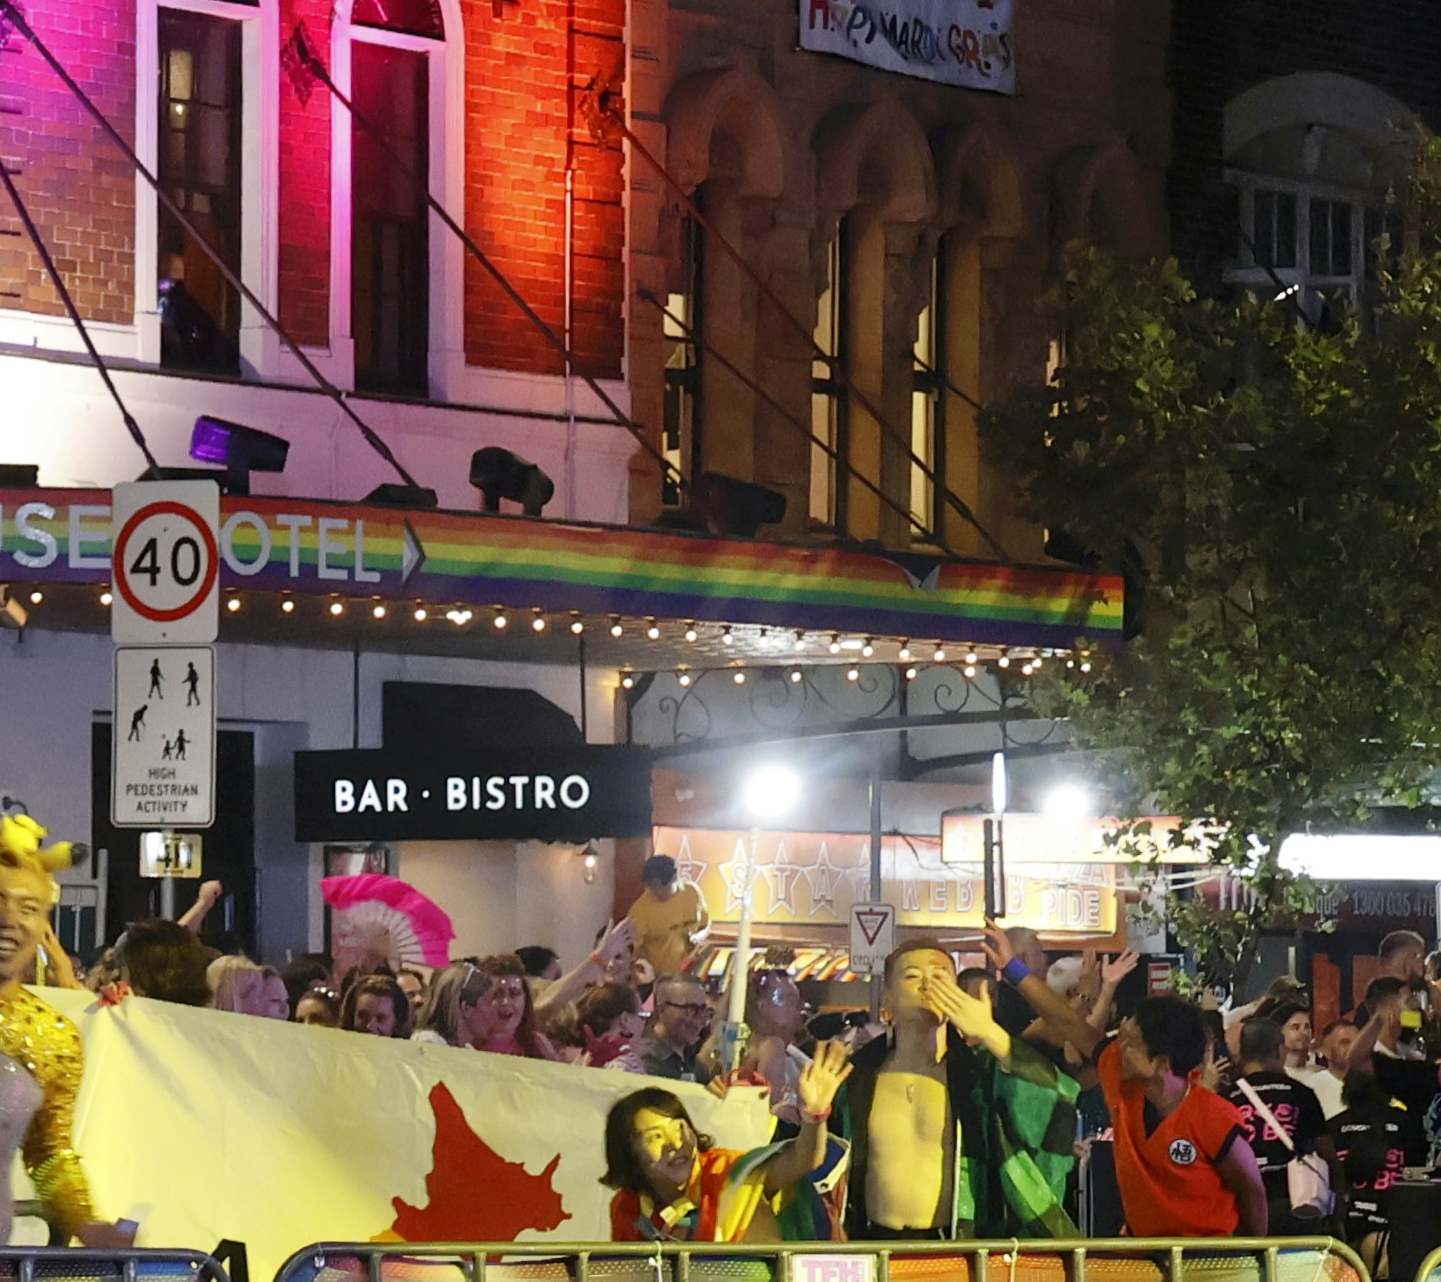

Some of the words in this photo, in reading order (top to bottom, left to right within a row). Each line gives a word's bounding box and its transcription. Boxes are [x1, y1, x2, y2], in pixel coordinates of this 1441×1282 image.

[130, 537, 201, 587] 40
[221, 511, 382, 584] OTEL
[125, 783, 199, 797] PEDESTRIAN
[148, 767, 176, 779] HIGH
[136, 800, 188, 813] ACTIVITY
[334, 779, 408, 812] BAR
[447, 775, 590, 810] BISTRO
[731, 863, 872, 903] STAR
[901, 877, 1024, 917] KEBB
[1042, 889, 1100, 928] PIDE
